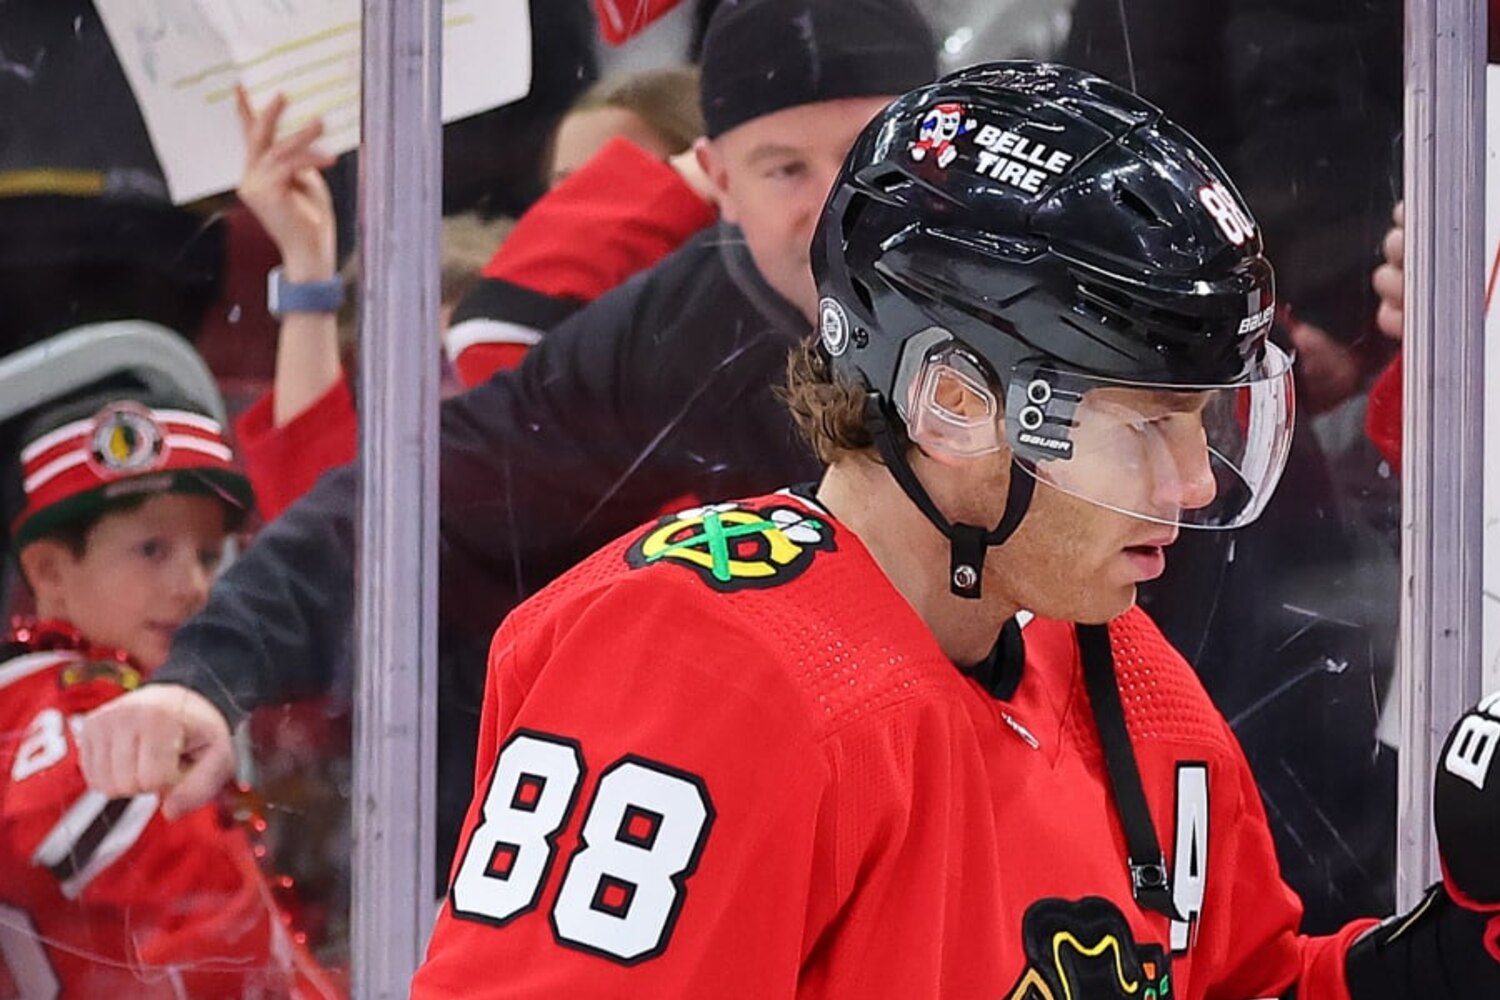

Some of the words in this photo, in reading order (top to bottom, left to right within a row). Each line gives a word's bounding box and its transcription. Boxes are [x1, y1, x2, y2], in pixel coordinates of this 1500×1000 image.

[973, 124, 1073, 174] BELLE
[975, 151, 1048, 193] TIRE
[450, 730, 716, 966] 88
